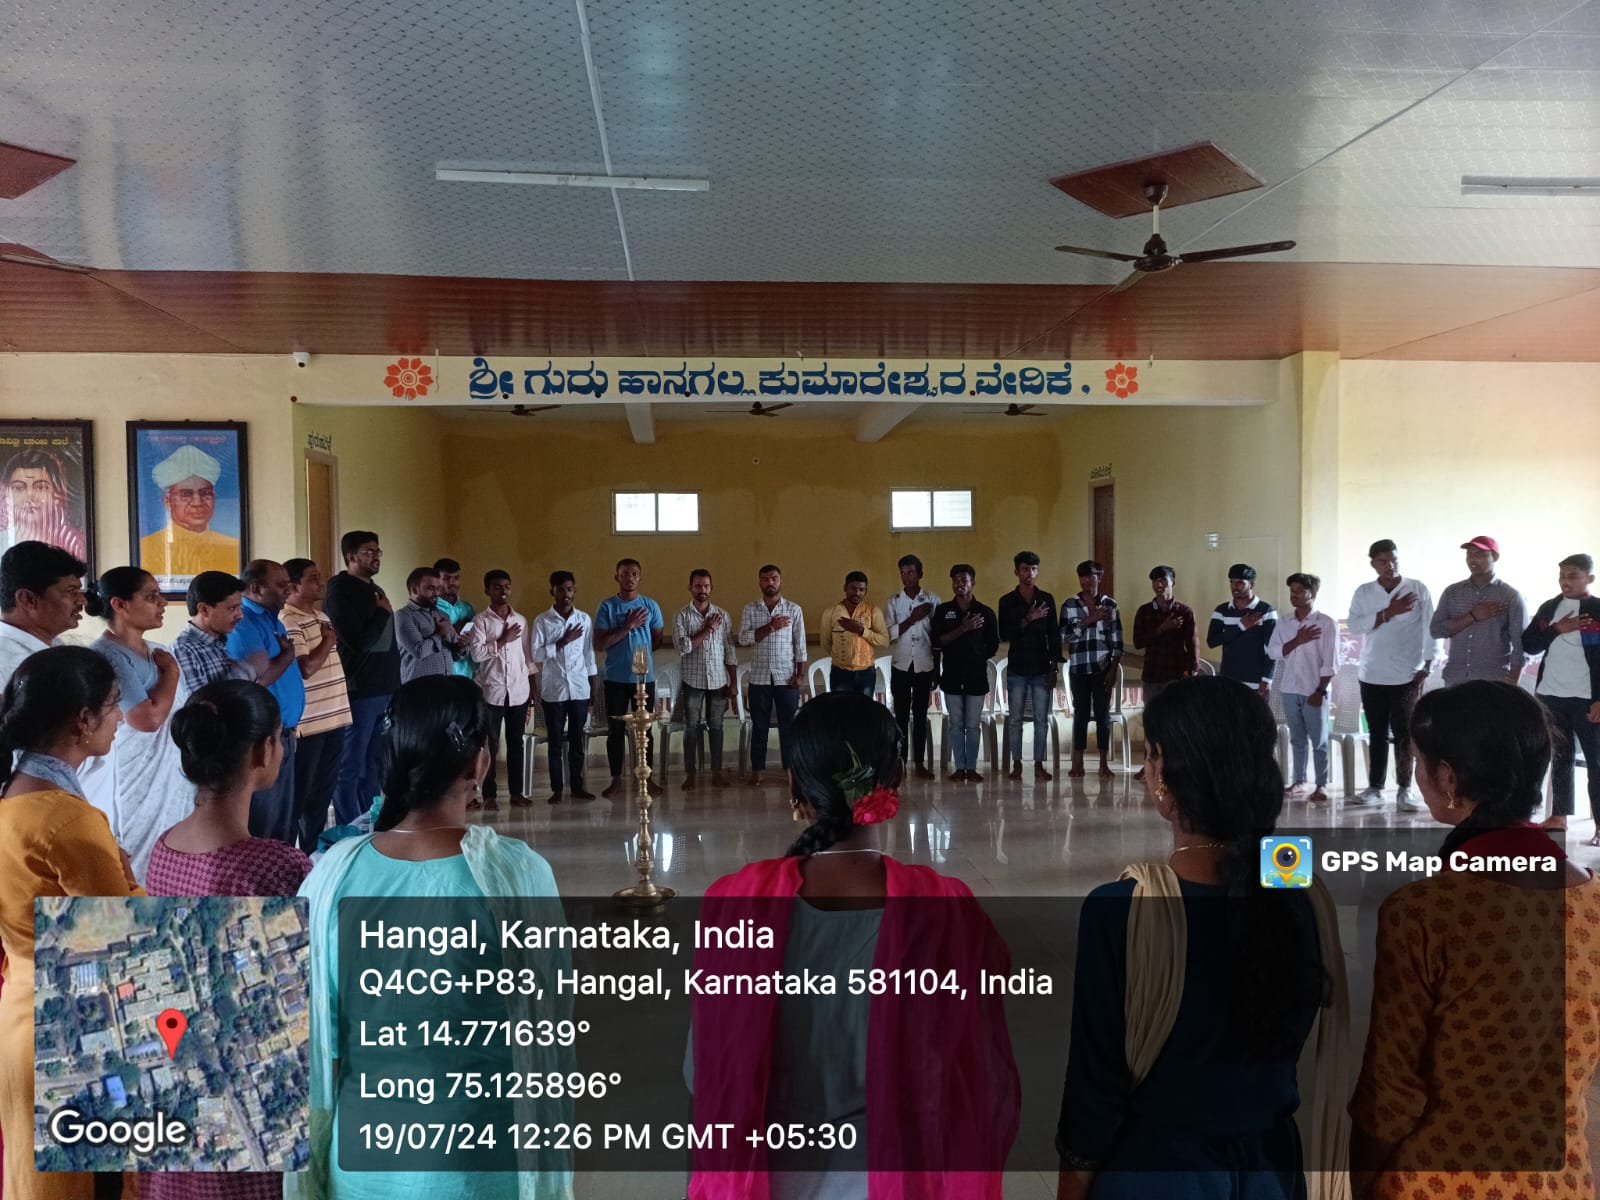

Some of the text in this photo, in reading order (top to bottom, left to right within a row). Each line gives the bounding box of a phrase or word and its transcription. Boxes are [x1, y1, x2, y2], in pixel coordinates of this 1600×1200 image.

[469, 357, 515, 400] ಶ್ರೀ
[523, 360, 609, 395] ಗುರು
[617, 360, 757, 396] ಹಾನಗಲ್ಲ
[758, 361, 967, 397] ಕುಮಾರೇಶ್ವರ
